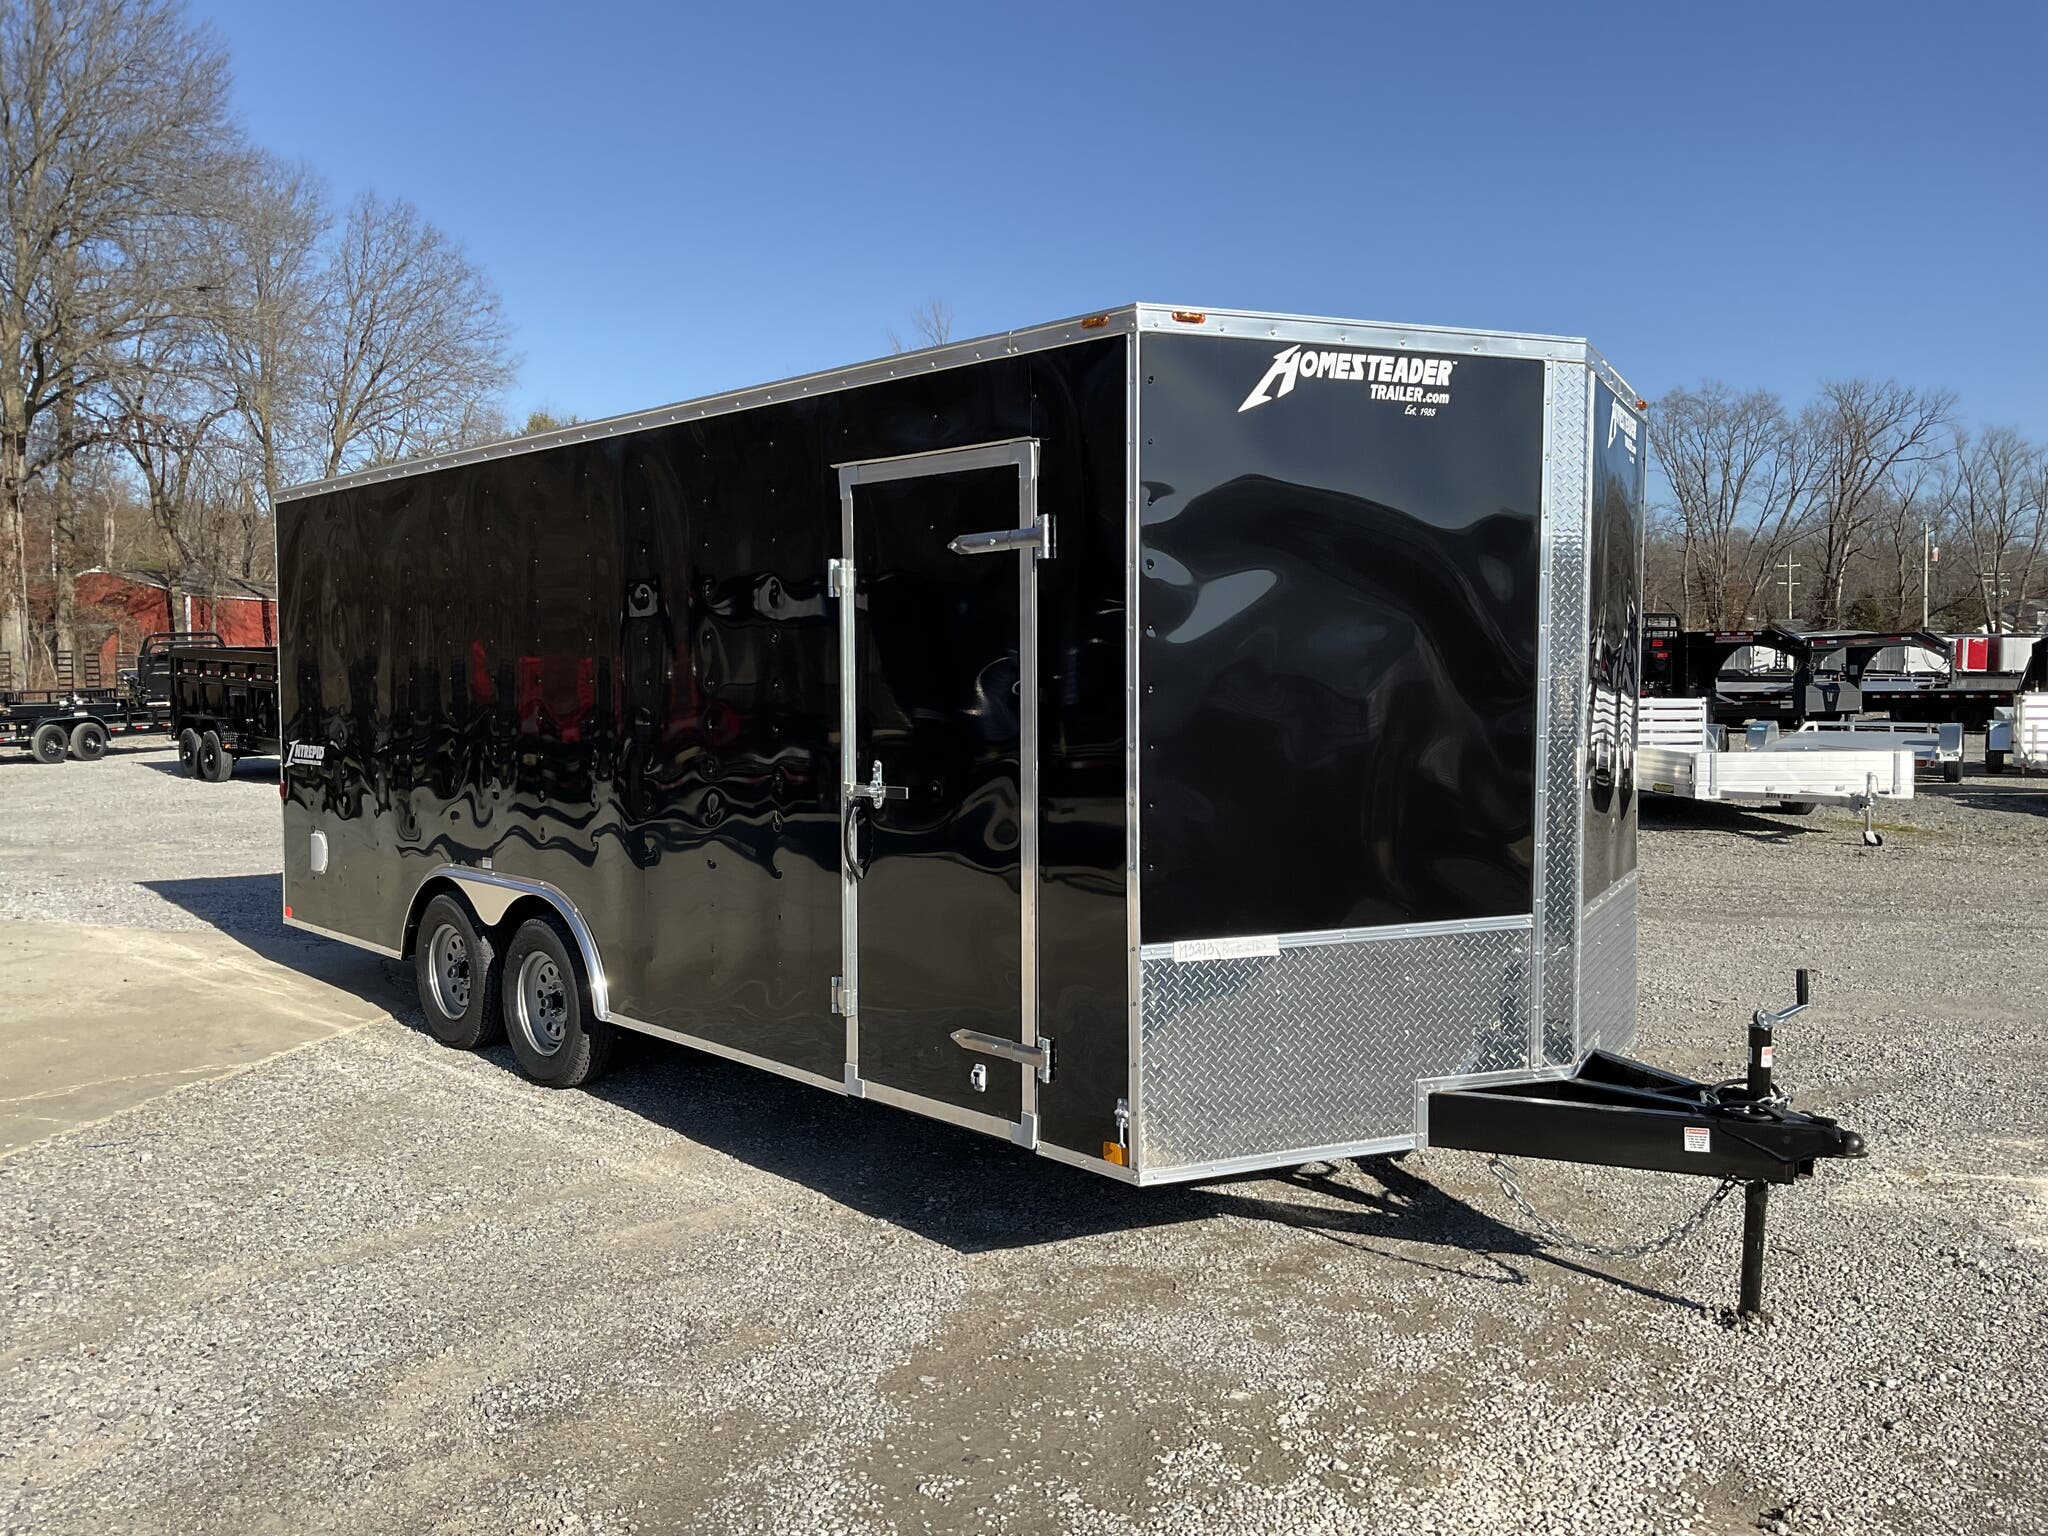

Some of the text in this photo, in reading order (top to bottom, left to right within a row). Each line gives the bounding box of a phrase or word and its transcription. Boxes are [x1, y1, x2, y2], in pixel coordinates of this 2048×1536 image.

[1370, 383, 1450, 404] TRAILER.com
[1404, 404, 1417, 416] Est.
[284, 739, 326, 768] INTREPID
